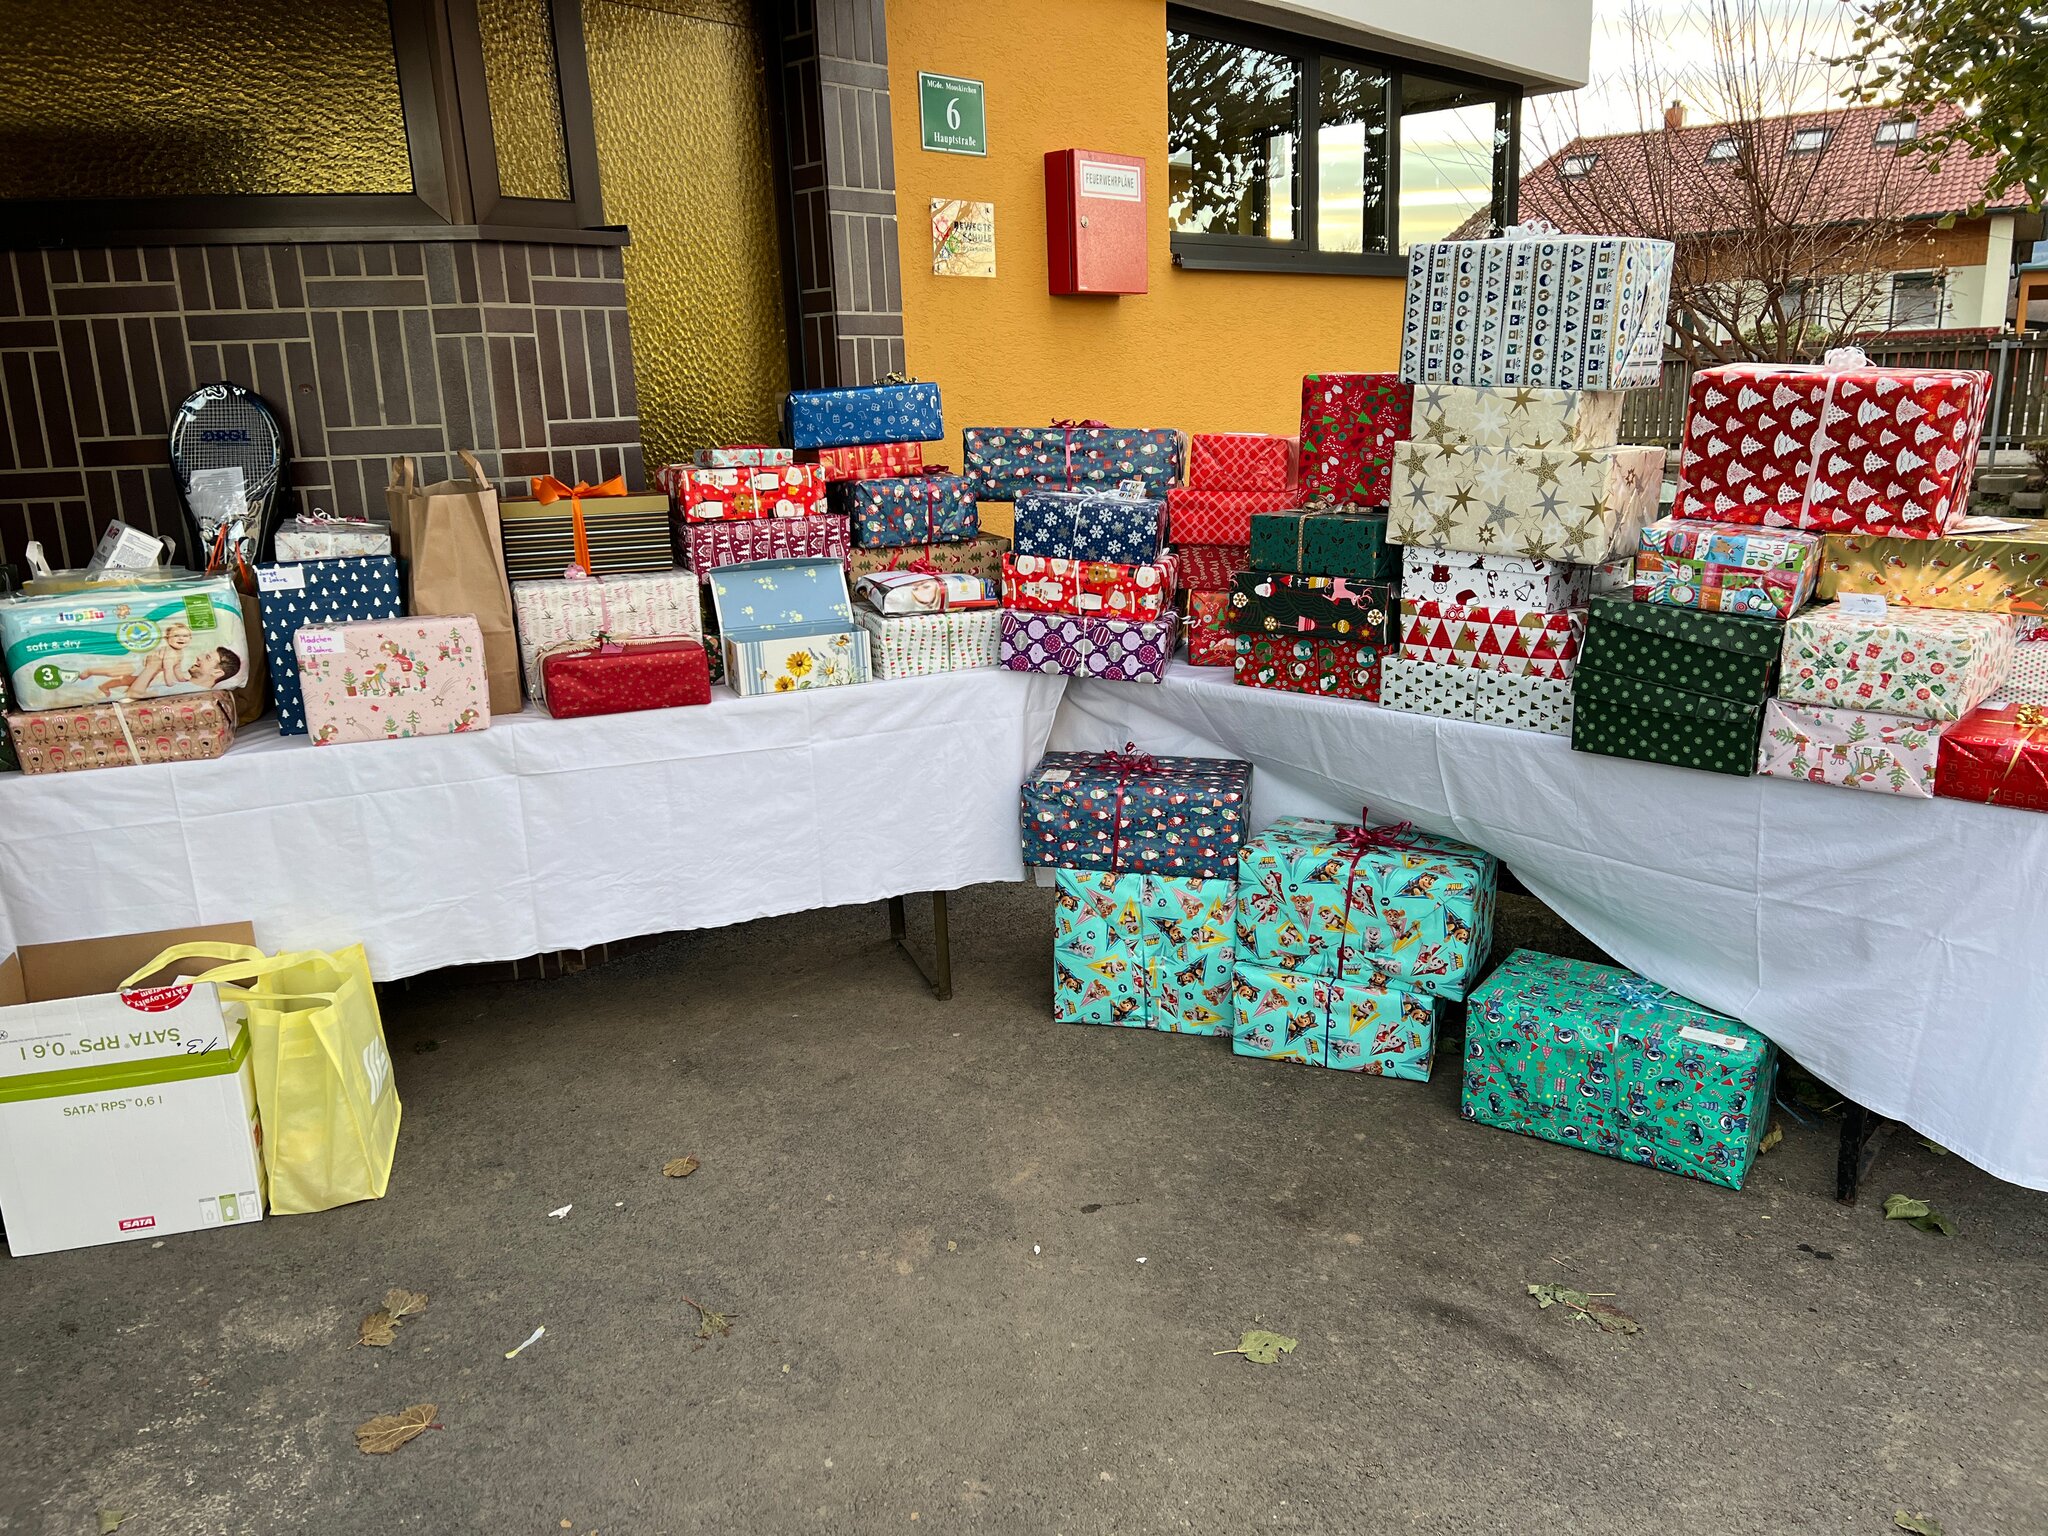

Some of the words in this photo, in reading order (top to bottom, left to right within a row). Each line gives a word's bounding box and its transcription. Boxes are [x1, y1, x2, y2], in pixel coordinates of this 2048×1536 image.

[927, 79, 944, 90] MGde.
[945, 82, 977, 95] Mooskirchen
[946, 97, 961, 130] 6
[933, 131, 977, 147] Hauptstraße
[1085, 172, 1135, 190] FEUERWEHRPLÄNE
[59, 610, 105, 623] lupilu
[26, 641, 49, 653] soft
[51, 641, 60, 649] &
[62, 639, 81, 650] dry
[41, 667, 54, 681] 3
[32, 1042, 66, 1060] 0,6
[134, 1095, 155, 1107] 0,6
[122, 1217, 154, 1230] SATA
